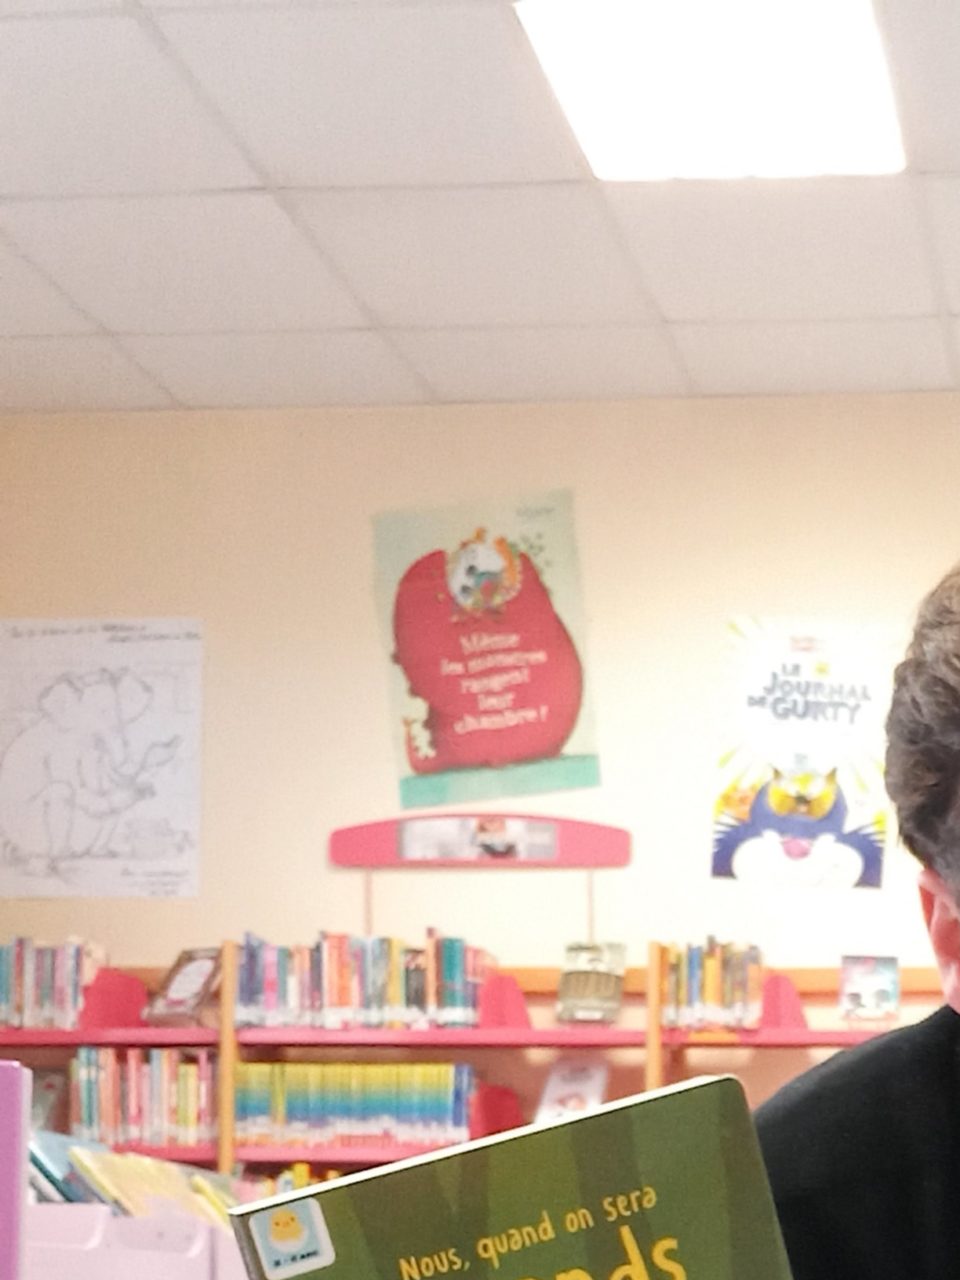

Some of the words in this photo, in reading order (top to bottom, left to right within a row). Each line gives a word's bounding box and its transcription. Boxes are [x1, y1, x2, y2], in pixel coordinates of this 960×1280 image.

[781, 662, 801, 678] LE
[477, 691, 516, 712] leur
[763, 671, 872, 702] JOURNAL
[747, 695, 768, 709] DE
[771, 697, 861, 725] GURTY
[477, 1210, 555, 1269] quand
[565, 1208, 594, 1233] on
[603, 1186, 657, 1221] sera
